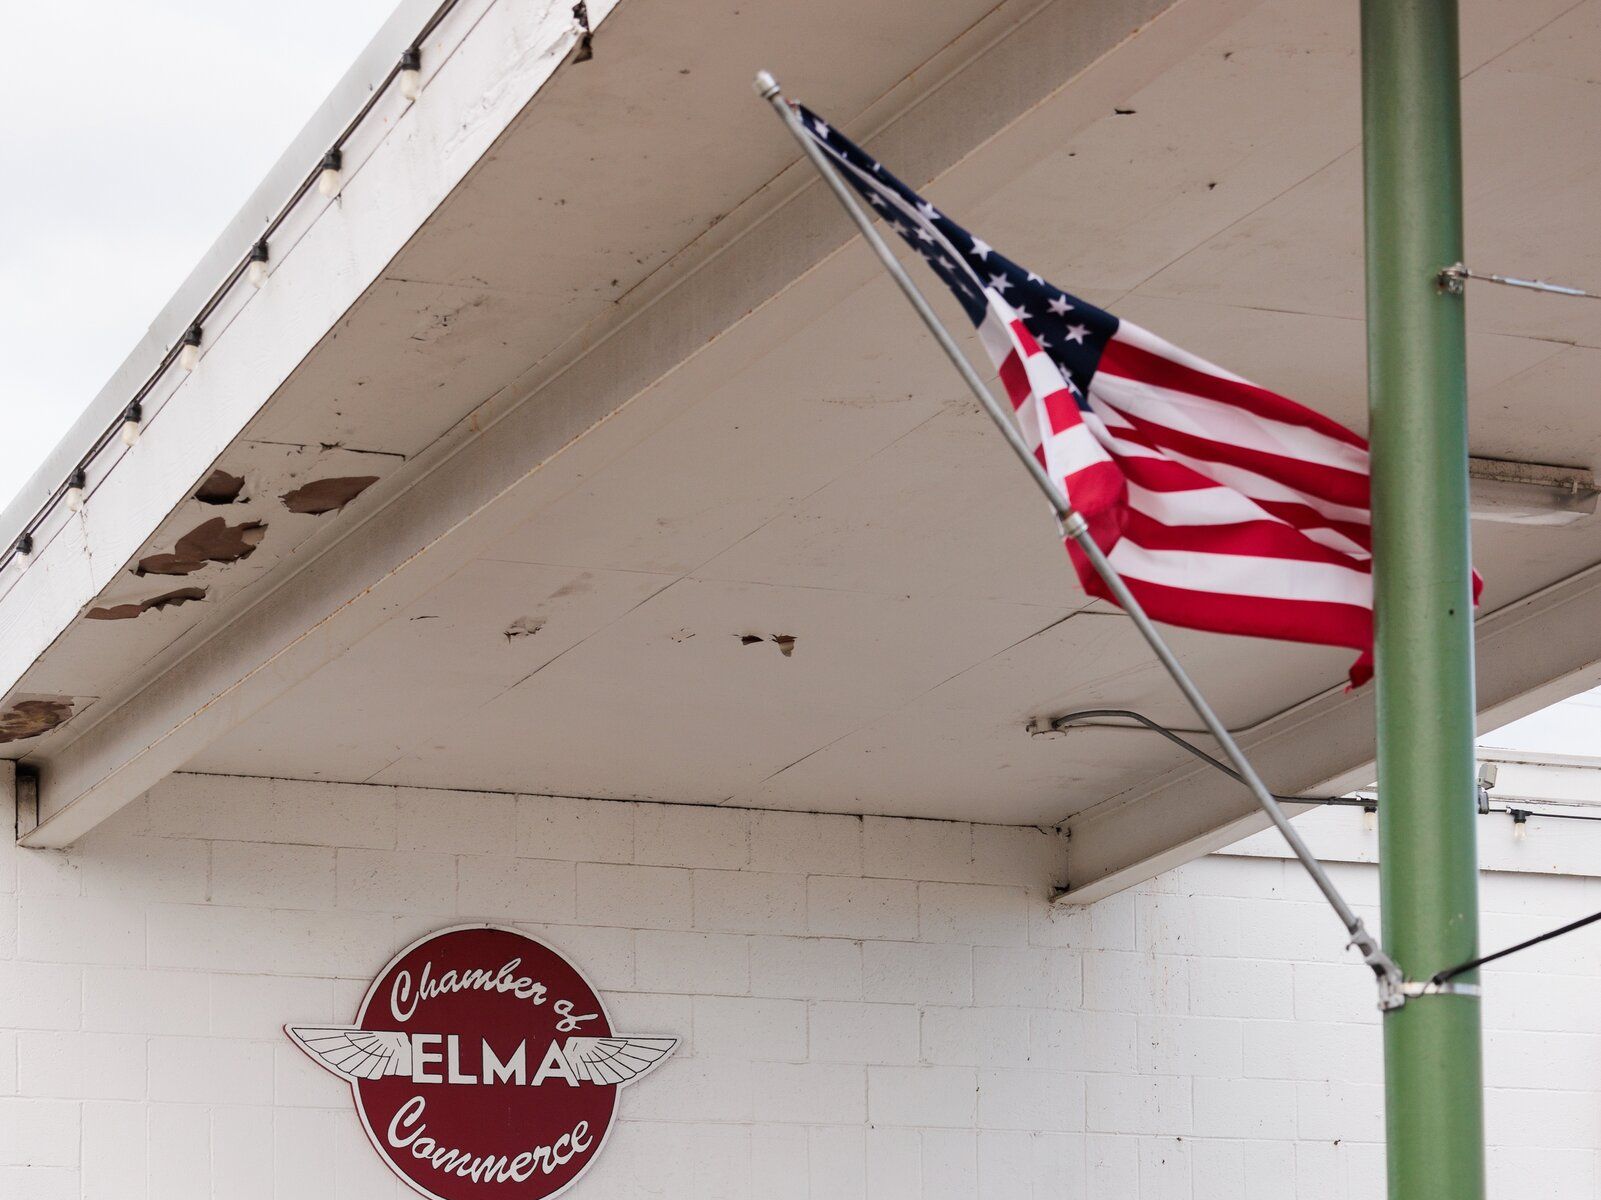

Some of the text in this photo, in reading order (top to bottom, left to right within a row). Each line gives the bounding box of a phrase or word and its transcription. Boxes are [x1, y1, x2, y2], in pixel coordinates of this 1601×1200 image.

[391, 958, 598, 1031] Chamber of
[412, 1034, 580, 1086] ELMA
[388, 1096, 593, 1182] Commerce
